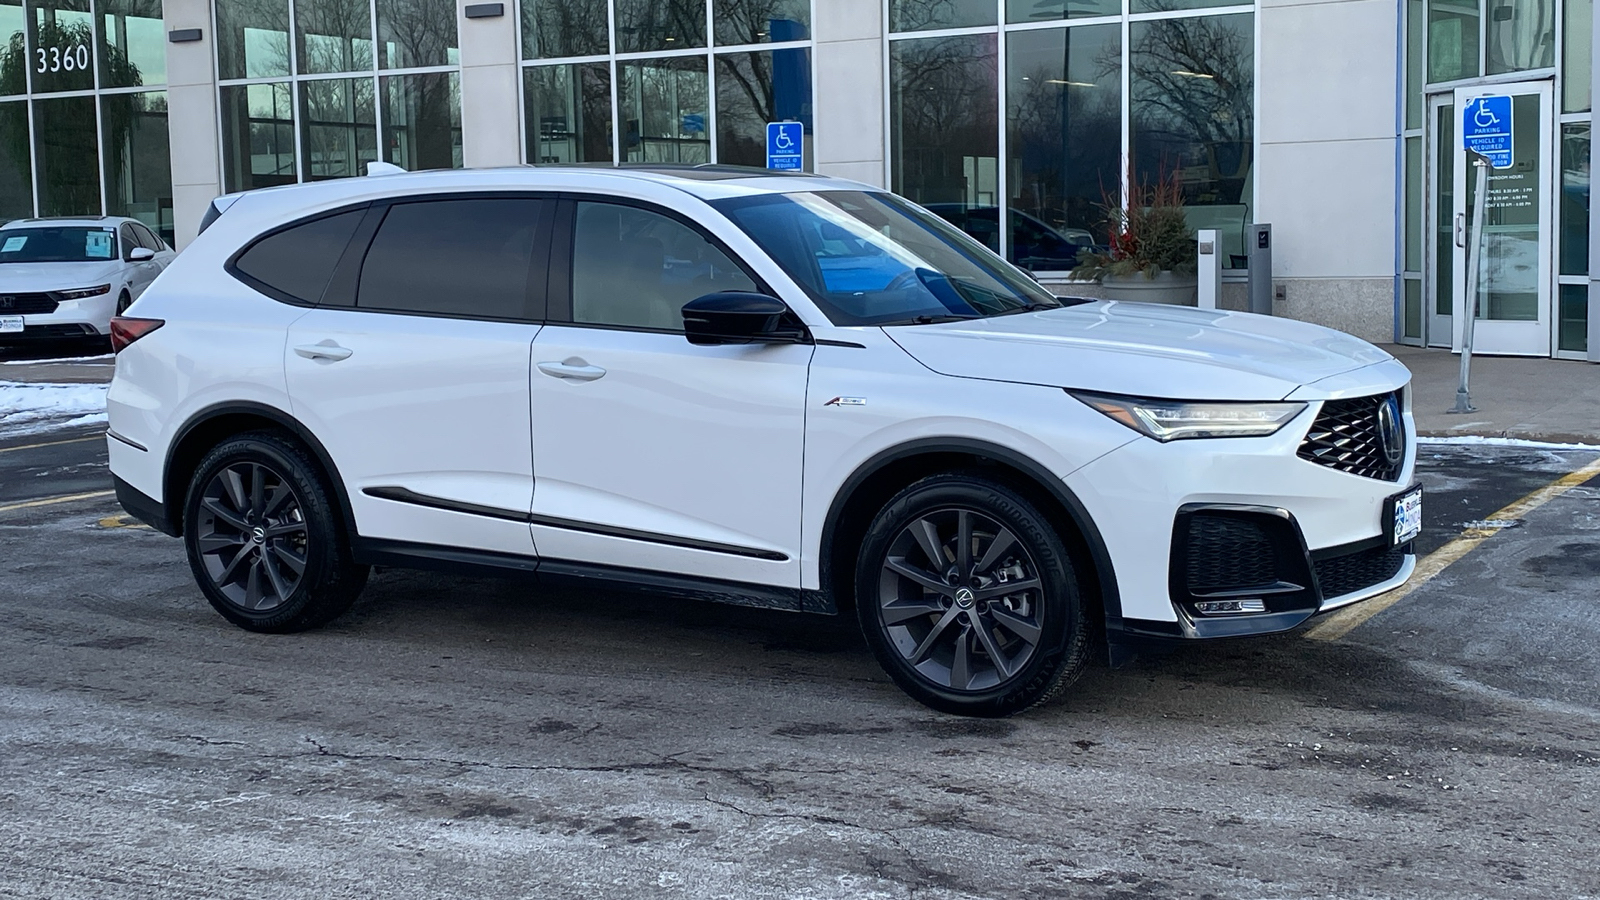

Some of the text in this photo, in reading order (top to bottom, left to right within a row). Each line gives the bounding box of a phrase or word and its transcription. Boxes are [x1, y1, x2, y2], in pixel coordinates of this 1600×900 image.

[37, 44, 88, 73] 3360
[987, 494, 1060, 576] BRIDGESTONE
[1006, 659, 1054, 703] ALENZA
